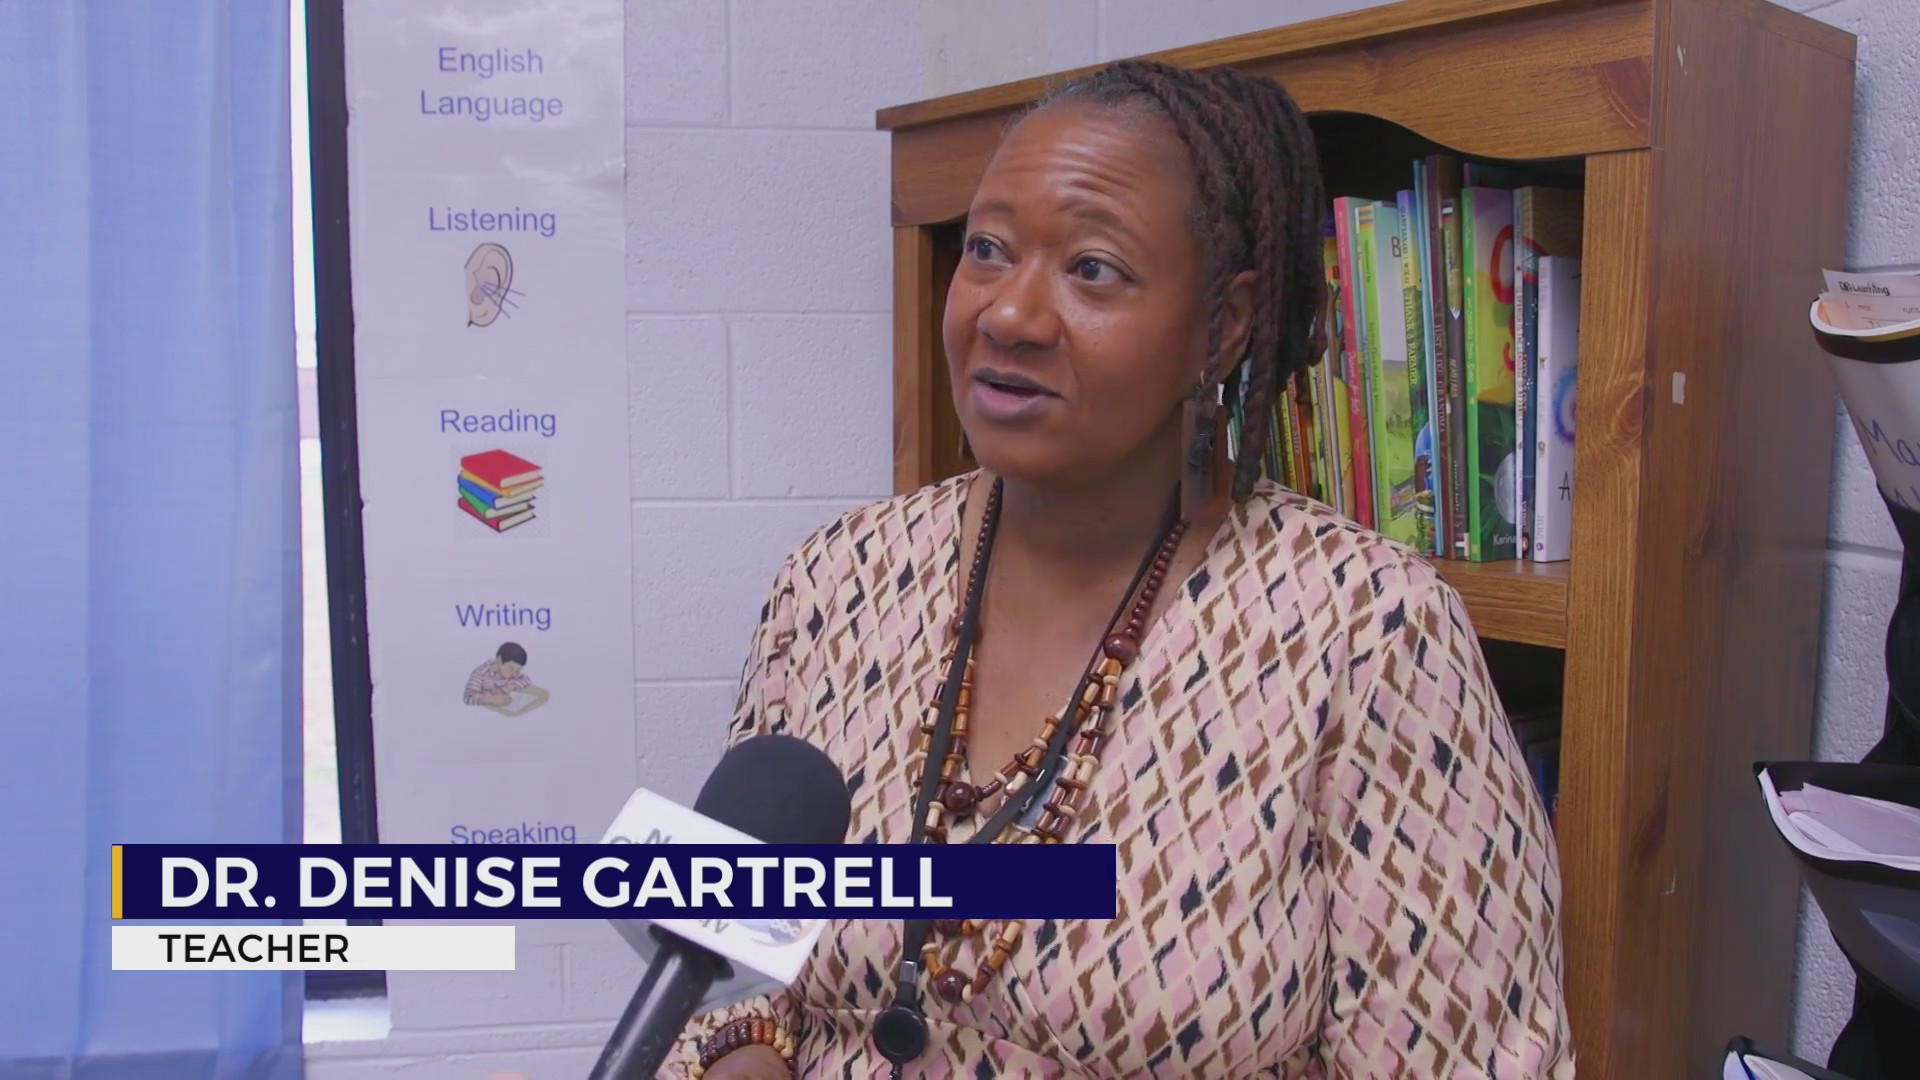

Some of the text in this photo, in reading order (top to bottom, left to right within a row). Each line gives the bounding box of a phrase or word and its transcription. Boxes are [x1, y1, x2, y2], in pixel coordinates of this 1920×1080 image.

[438, 46, 544, 80] English
[420, 89, 564, 123] Language
[428, 206, 556, 238] Listening
[1404, 295, 1416, 331] THANK
[1407, 342, 1418, 385] FARMER
[1434, 324, 1447, 432] JUST LIKE GRANDMA
[440, 409, 556, 438] Reading
[455, 603, 552, 631] Writing
[451, 821, 576, 844] Speaking
